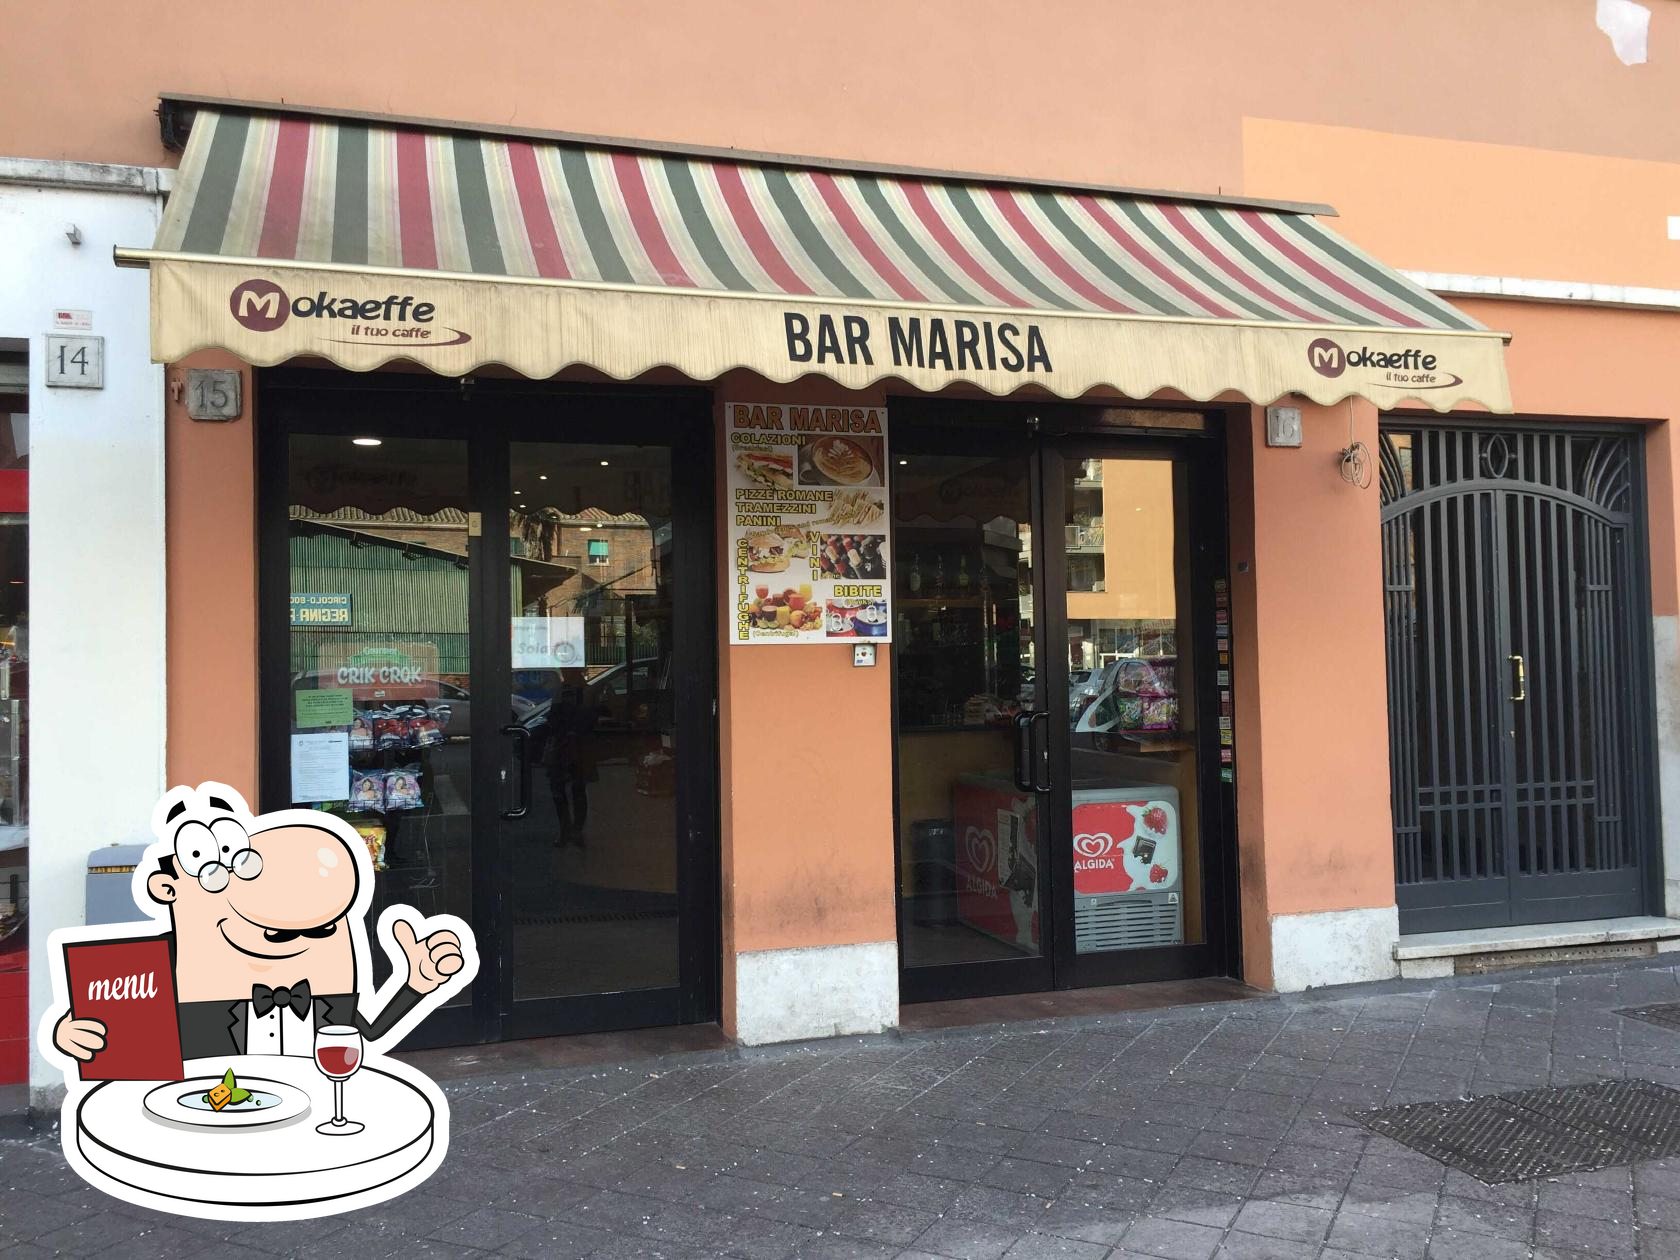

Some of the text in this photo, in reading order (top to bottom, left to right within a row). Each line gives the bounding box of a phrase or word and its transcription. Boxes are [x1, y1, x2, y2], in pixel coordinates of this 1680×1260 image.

[236, 287, 435, 323] Mokaeffe
[351, 325, 360, 335] il
[364, 326, 389, 337] tuo
[784, 312, 1053, 373] BAR MARISA
[57, 345, 89, 375] 14
[1311, 345, 1437, 371] Mokaeffe
[1386, 371, 1392, 381] il
[1394, 373, 1409, 382] tuo
[193, 380, 228, 409] 15
[733, 404, 882, 433] BAR MARISA
[731, 432, 806, 445] COLAZIONI
[735, 489, 833, 501] PIZZE ROMANE
[735, 502, 816, 514] TRAMEZZINI
[736, 515, 781, 526] PANINI
[809, 531, 820, 581] VINI
[736, 539, 750, 641] CENTRIFUGHE
[834, 585, 882, 597] BIBITE
[337, 667, 376, 685] CRIK
[1074, 858, 1115, 873] ALGIDA
